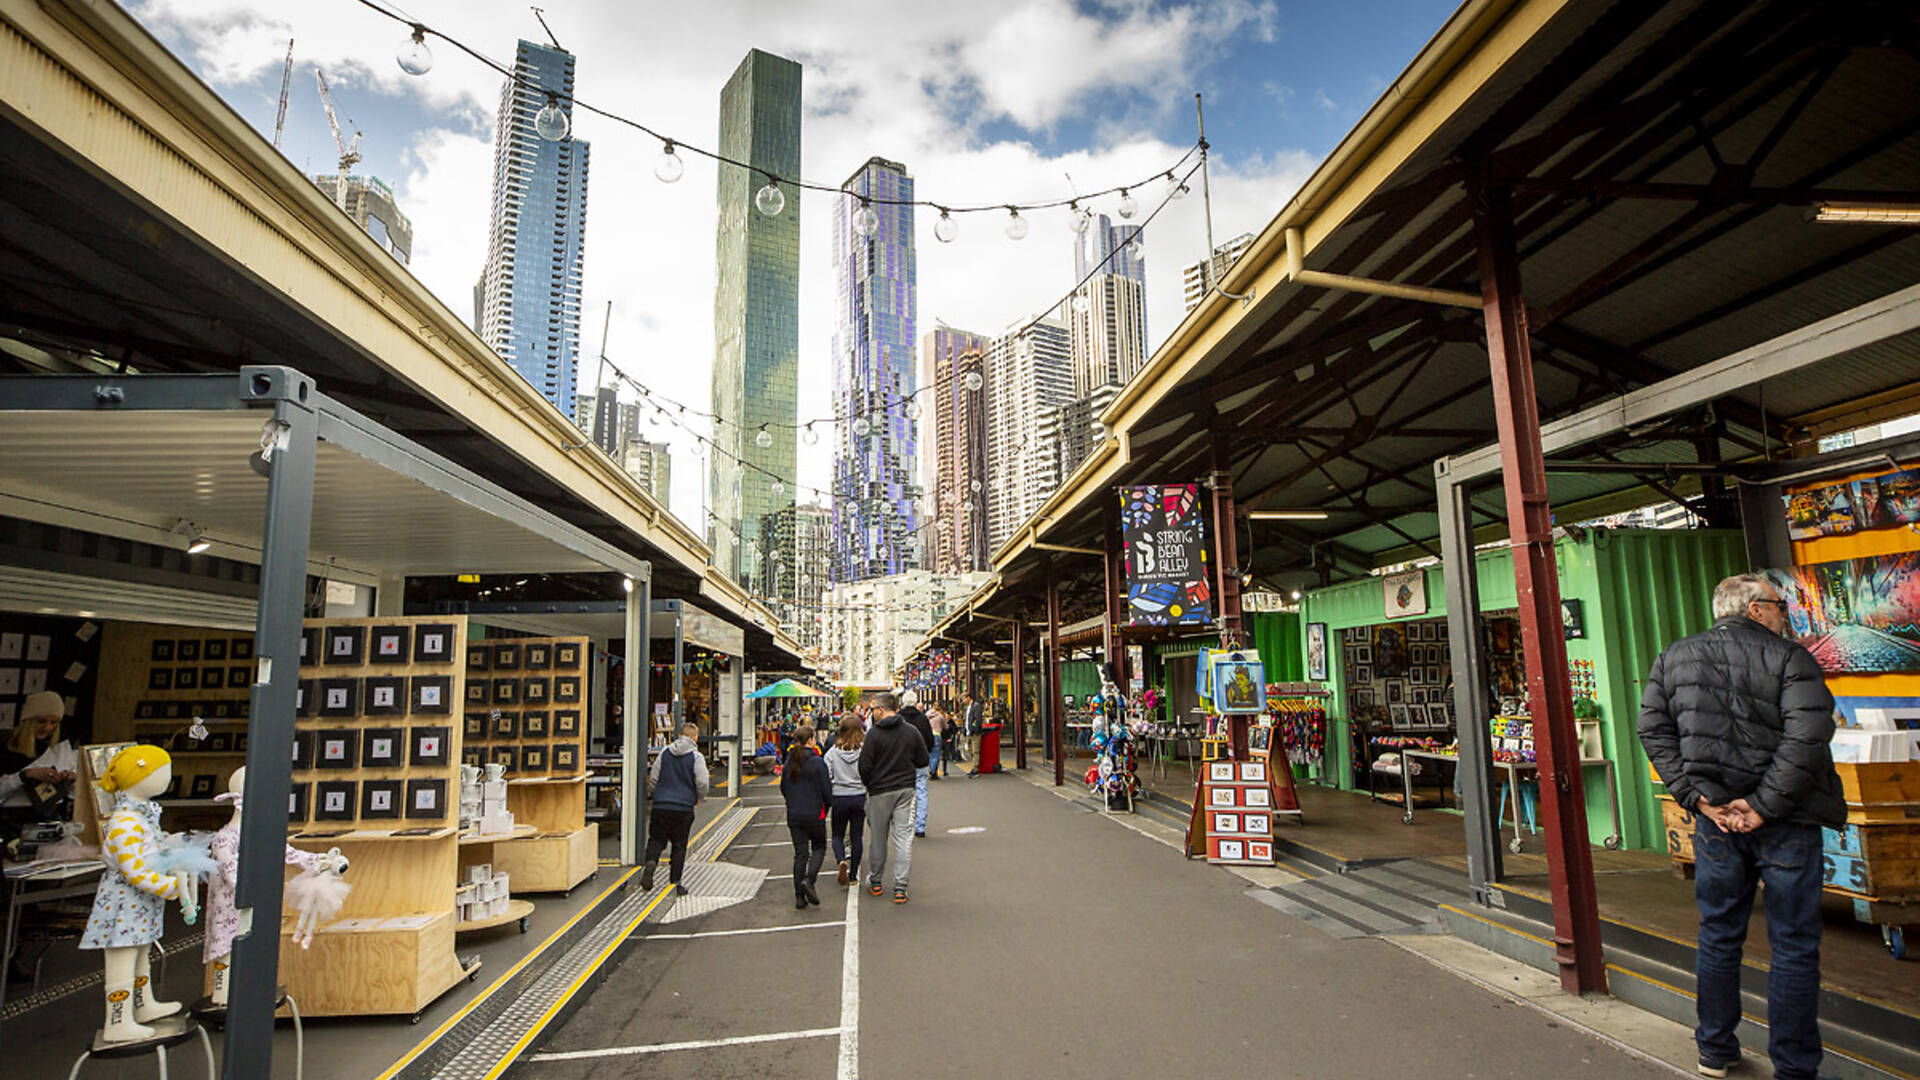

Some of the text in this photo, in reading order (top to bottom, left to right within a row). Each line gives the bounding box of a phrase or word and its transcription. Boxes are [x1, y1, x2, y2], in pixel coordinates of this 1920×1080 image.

[1156, 529, 1193, 544] STRING
[1158, 544, 1185, 558] BEAN
[1159, 557, 1189, 572] ALLEY
